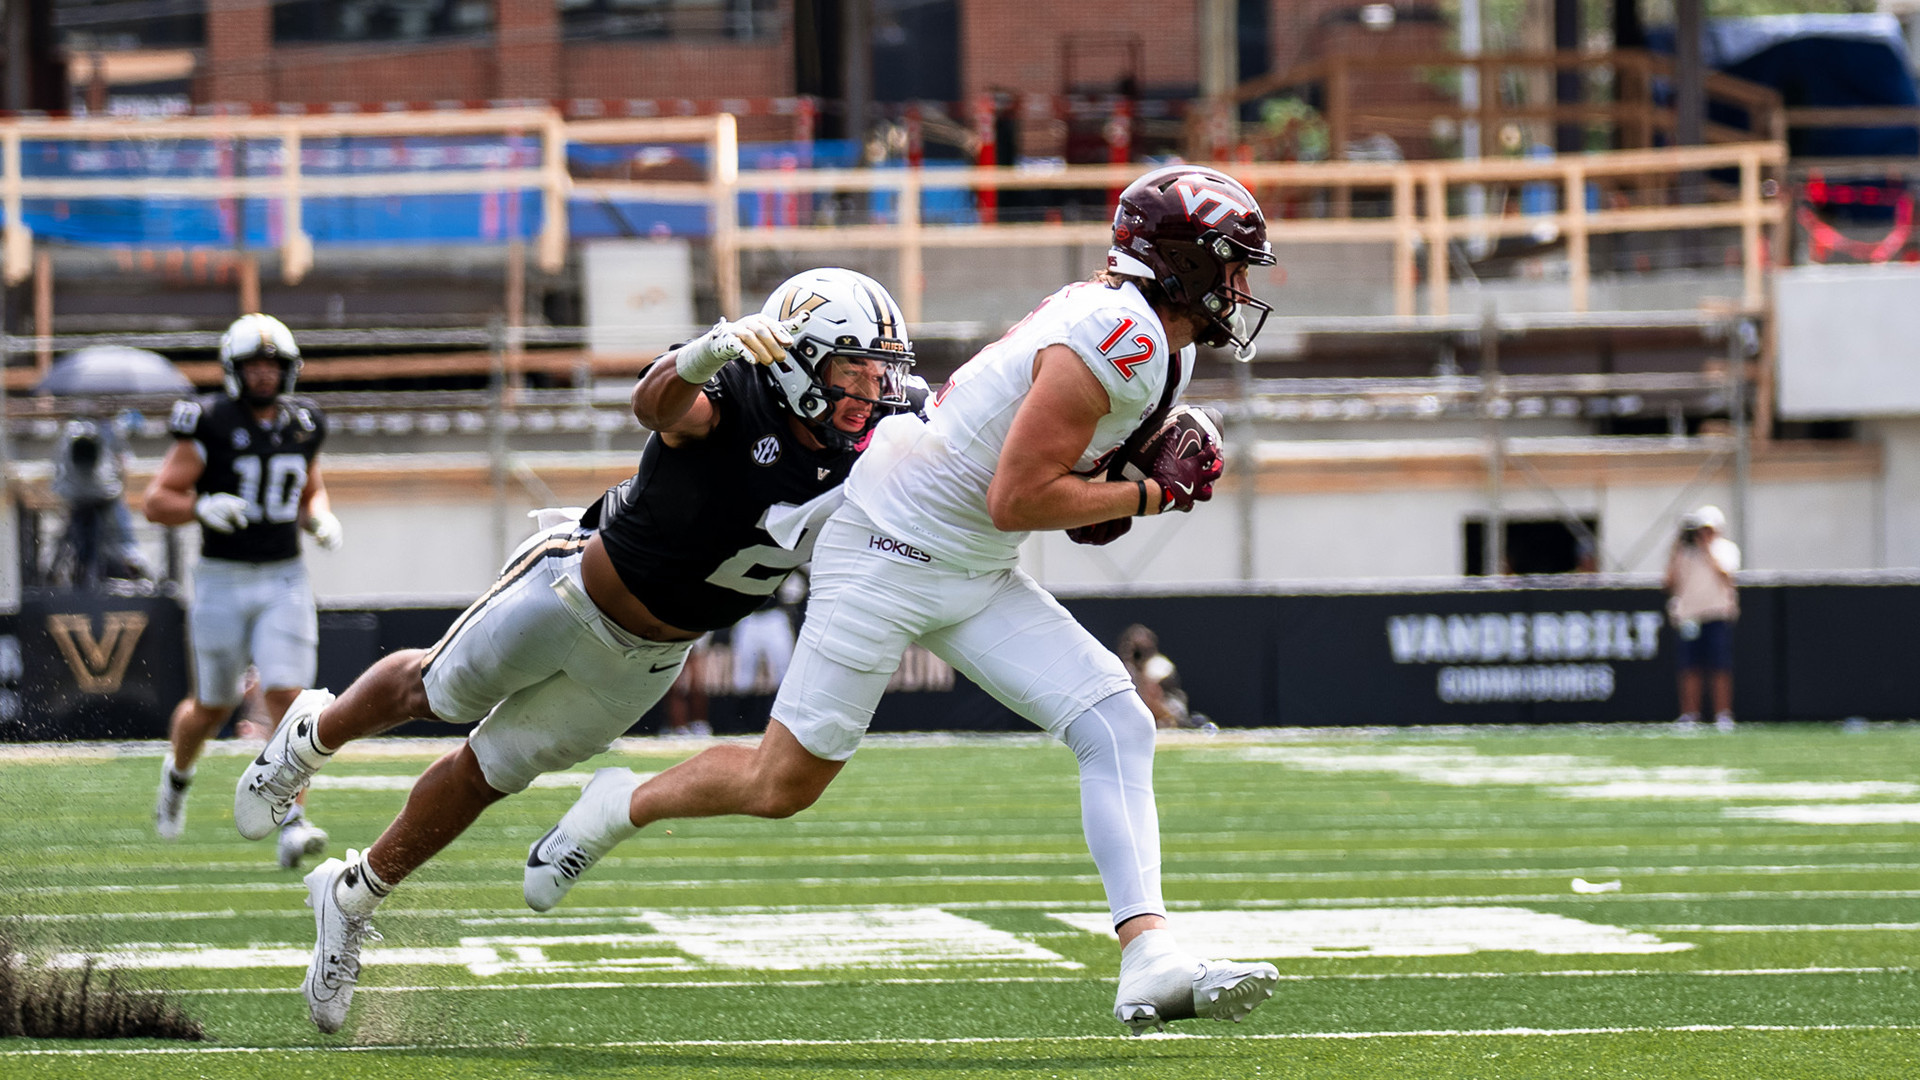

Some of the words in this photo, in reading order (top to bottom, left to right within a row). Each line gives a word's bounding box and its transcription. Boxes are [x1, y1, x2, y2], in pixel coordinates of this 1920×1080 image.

[1174, 182, 1251, 229] VT
[779, 285, 831, 321] V
[1096, 316, 1157, 383] 12
[753, 436, 779, 464] SEC
[817, 467, 831, 480] V
[232, 453, 308, 524] 10
[705, 501, 824, 596] 2
[868, 535, 932, 563] HOKIES
[46, 610, 149, 694] V
[1388, 611, 1664, 663] VANDERBILT
